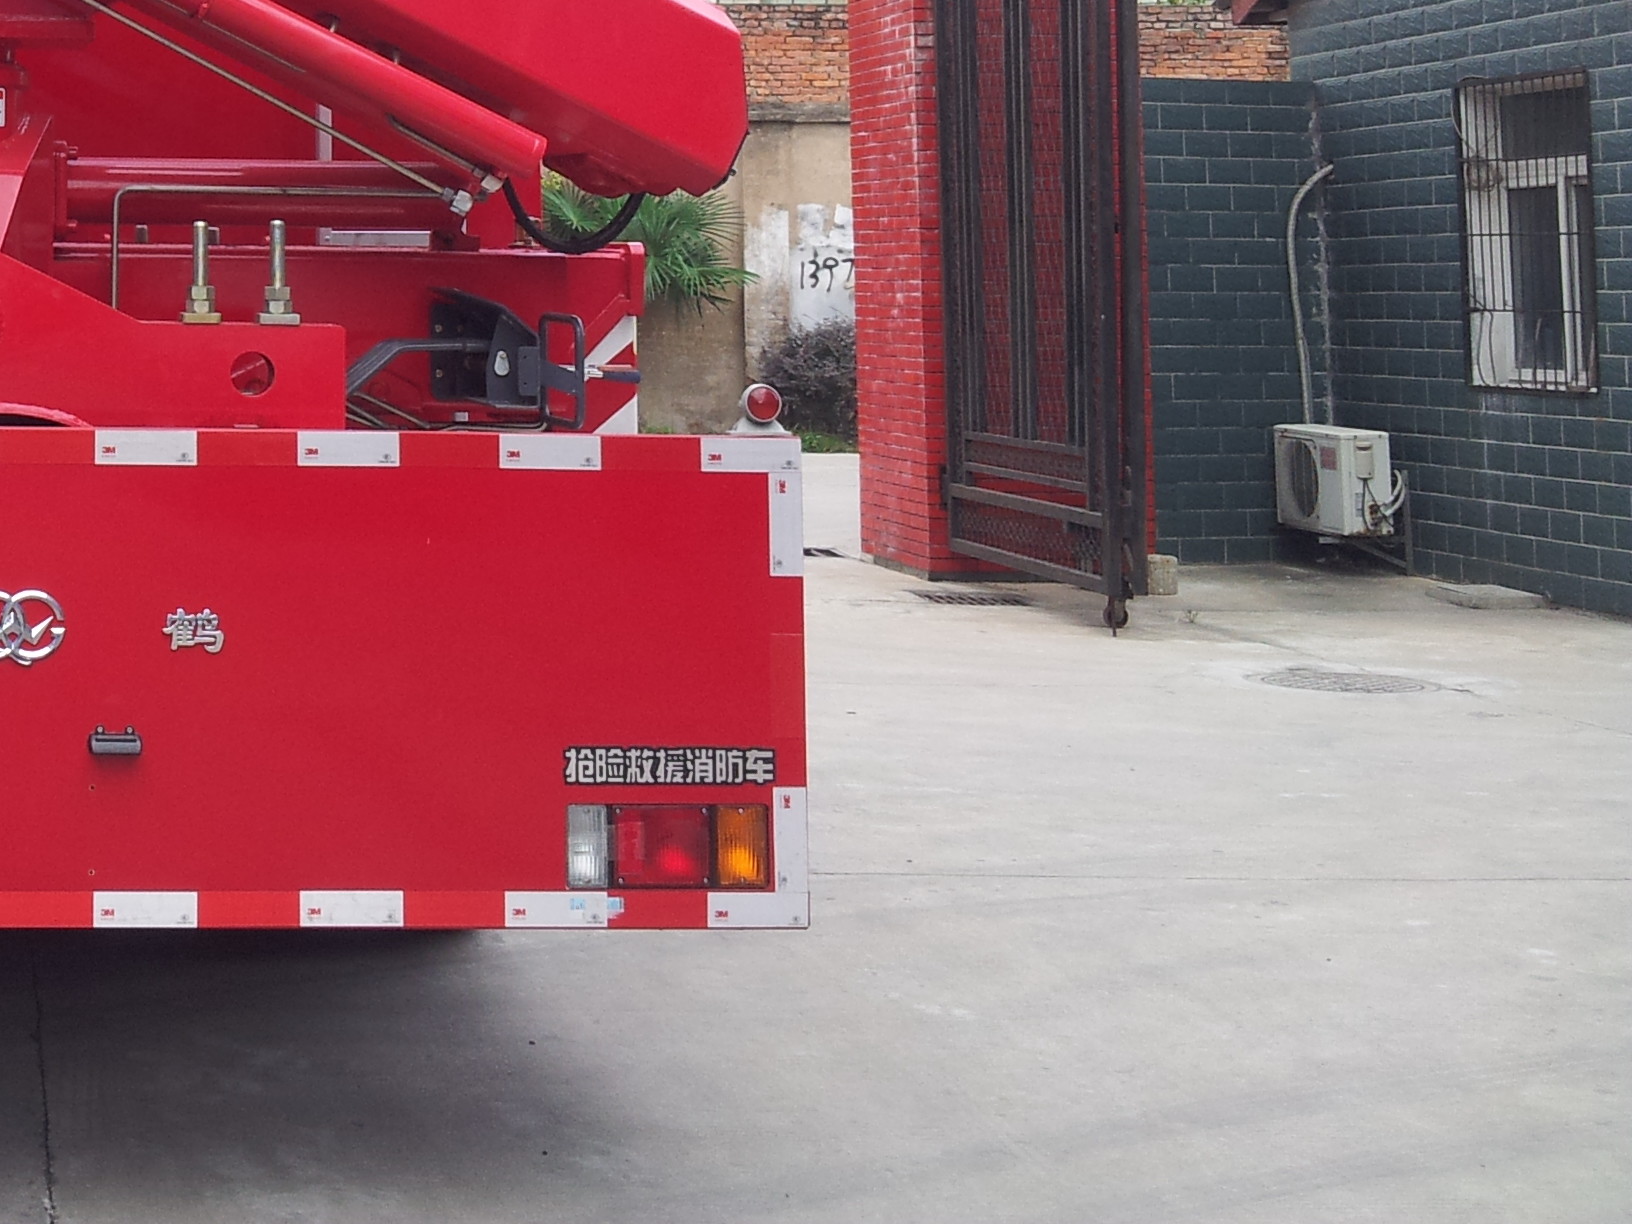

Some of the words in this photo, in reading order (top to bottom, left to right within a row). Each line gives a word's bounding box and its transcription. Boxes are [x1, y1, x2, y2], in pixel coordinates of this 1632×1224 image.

[162, 608, 225, 653] 鹤
[564, 747, 775, 785] 抢险救援消防车
